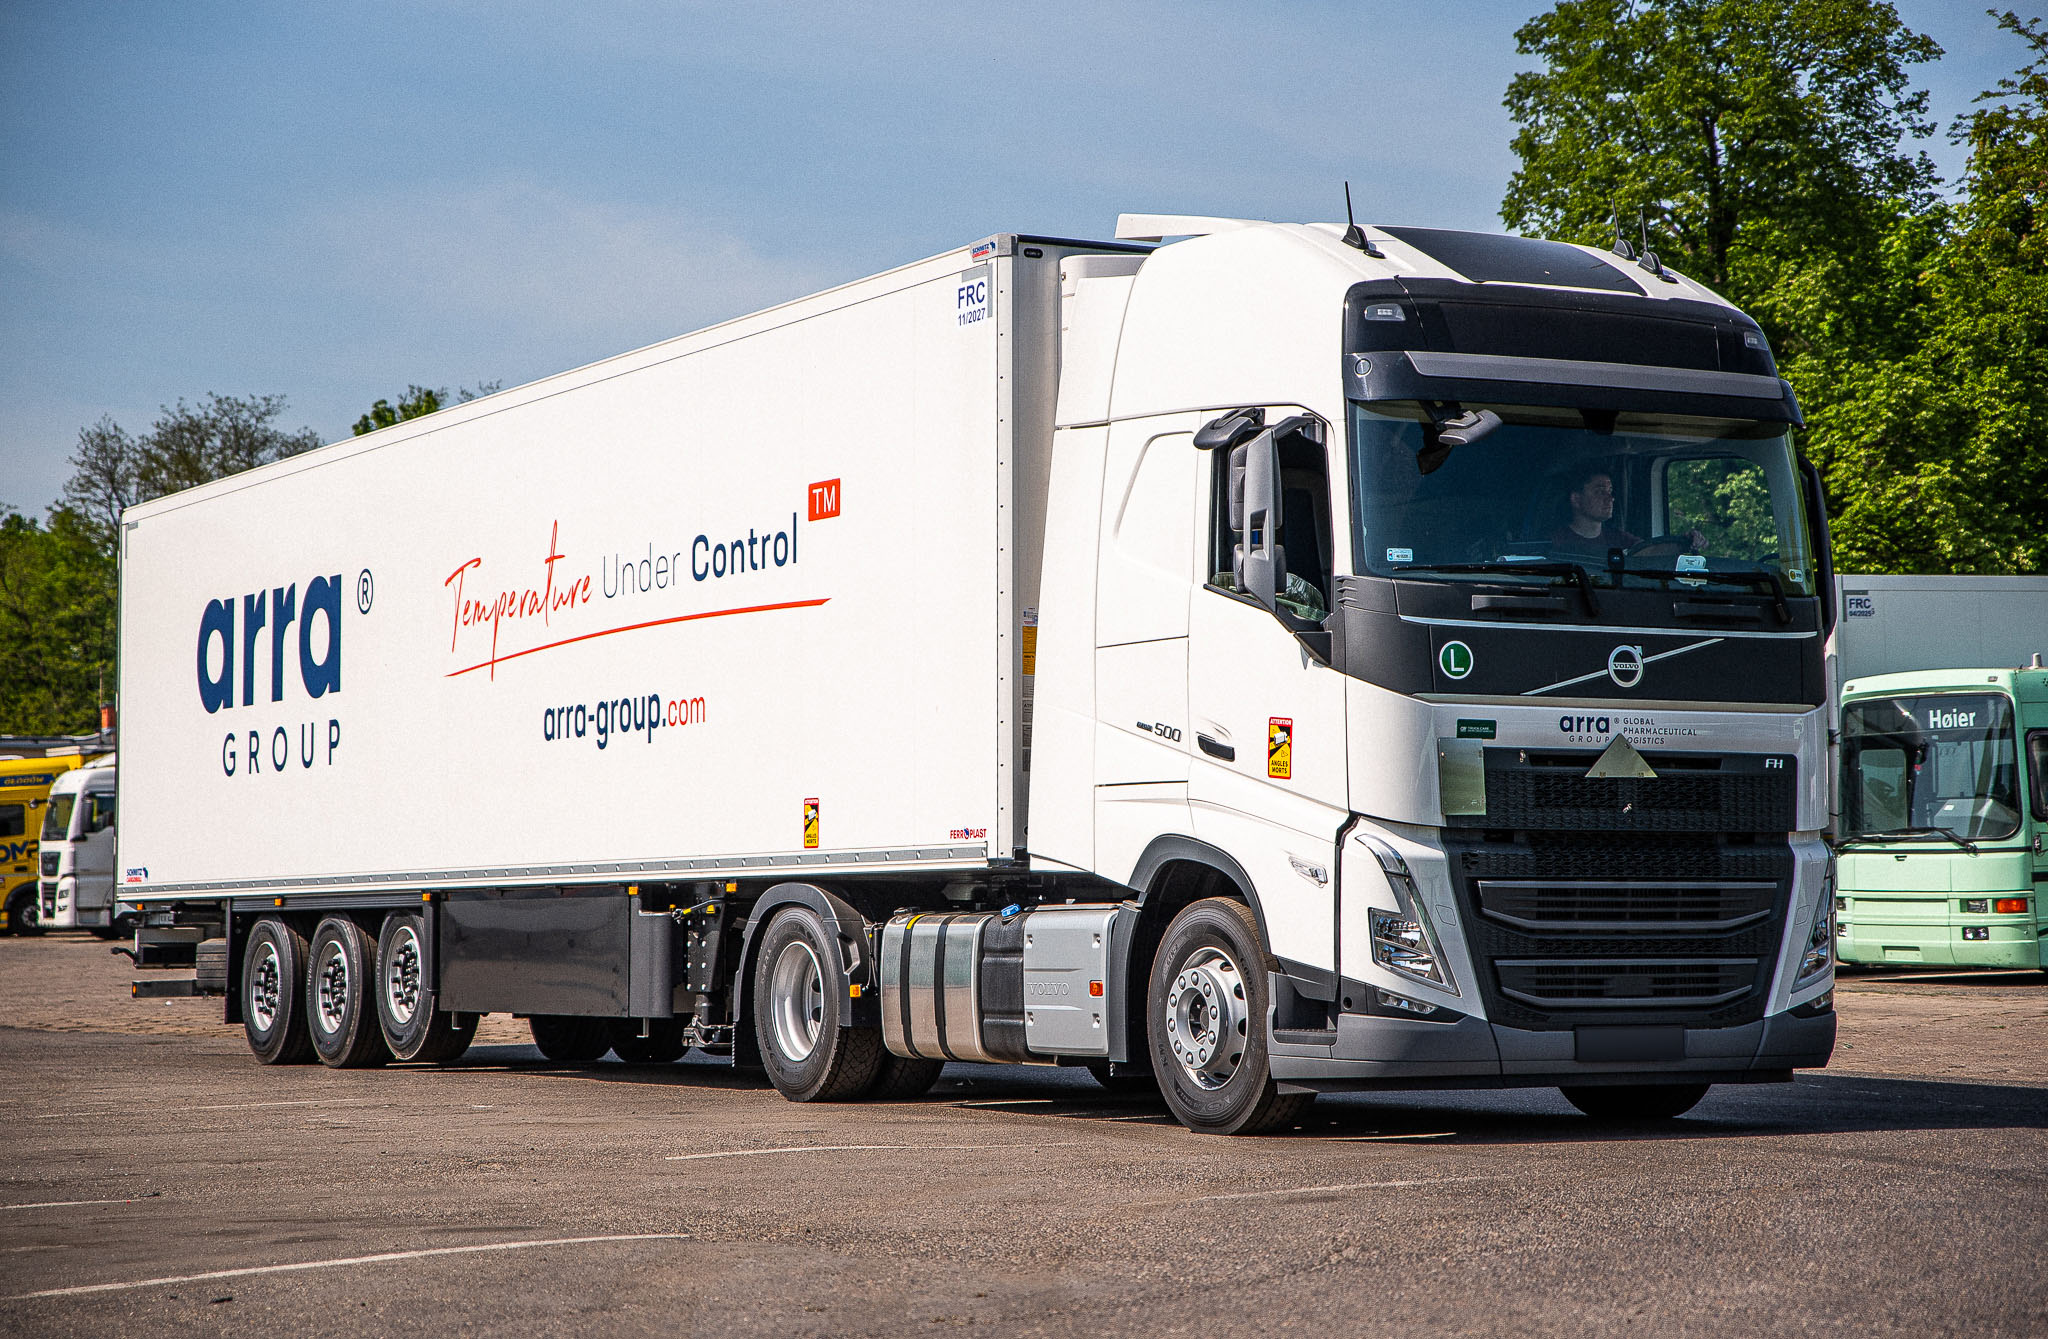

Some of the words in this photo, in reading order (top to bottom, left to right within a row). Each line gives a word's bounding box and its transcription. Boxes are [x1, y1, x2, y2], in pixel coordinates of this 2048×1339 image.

[958, 281, 985, 309] FRC
[958, 308, 986, 326] 11/2027
[445, 519, 592, 681] Temperature
[604, 543, 680, 598] Under
[692, 512, 797, 582] Control
[812, 485, 836, 514] TM
[1849, 599, 1871, 609] FRC
[197, 574, 341, 714] arra
[1450, 649, 1465, 671] L
[544, 694, 705, 749] arra-group.com
[1559, 715, 1610, 733] arra
[1623, 717, 1655, 726] GLOBAL
[1929, 708, 1976, 729] Høier
[1155, 723, 1182, 743] 500
[1569, 735, 1610, 743] GROUP
[1623, 727, 1698, 736] PHARMACEUTICAL
[223, 719, 341, 777] GROUP
[1627, 737, 1665, 745] OGISTICS
[1766, 759, 1783, 768] FH
[1027, 982, 1070, 996] VOLVO
